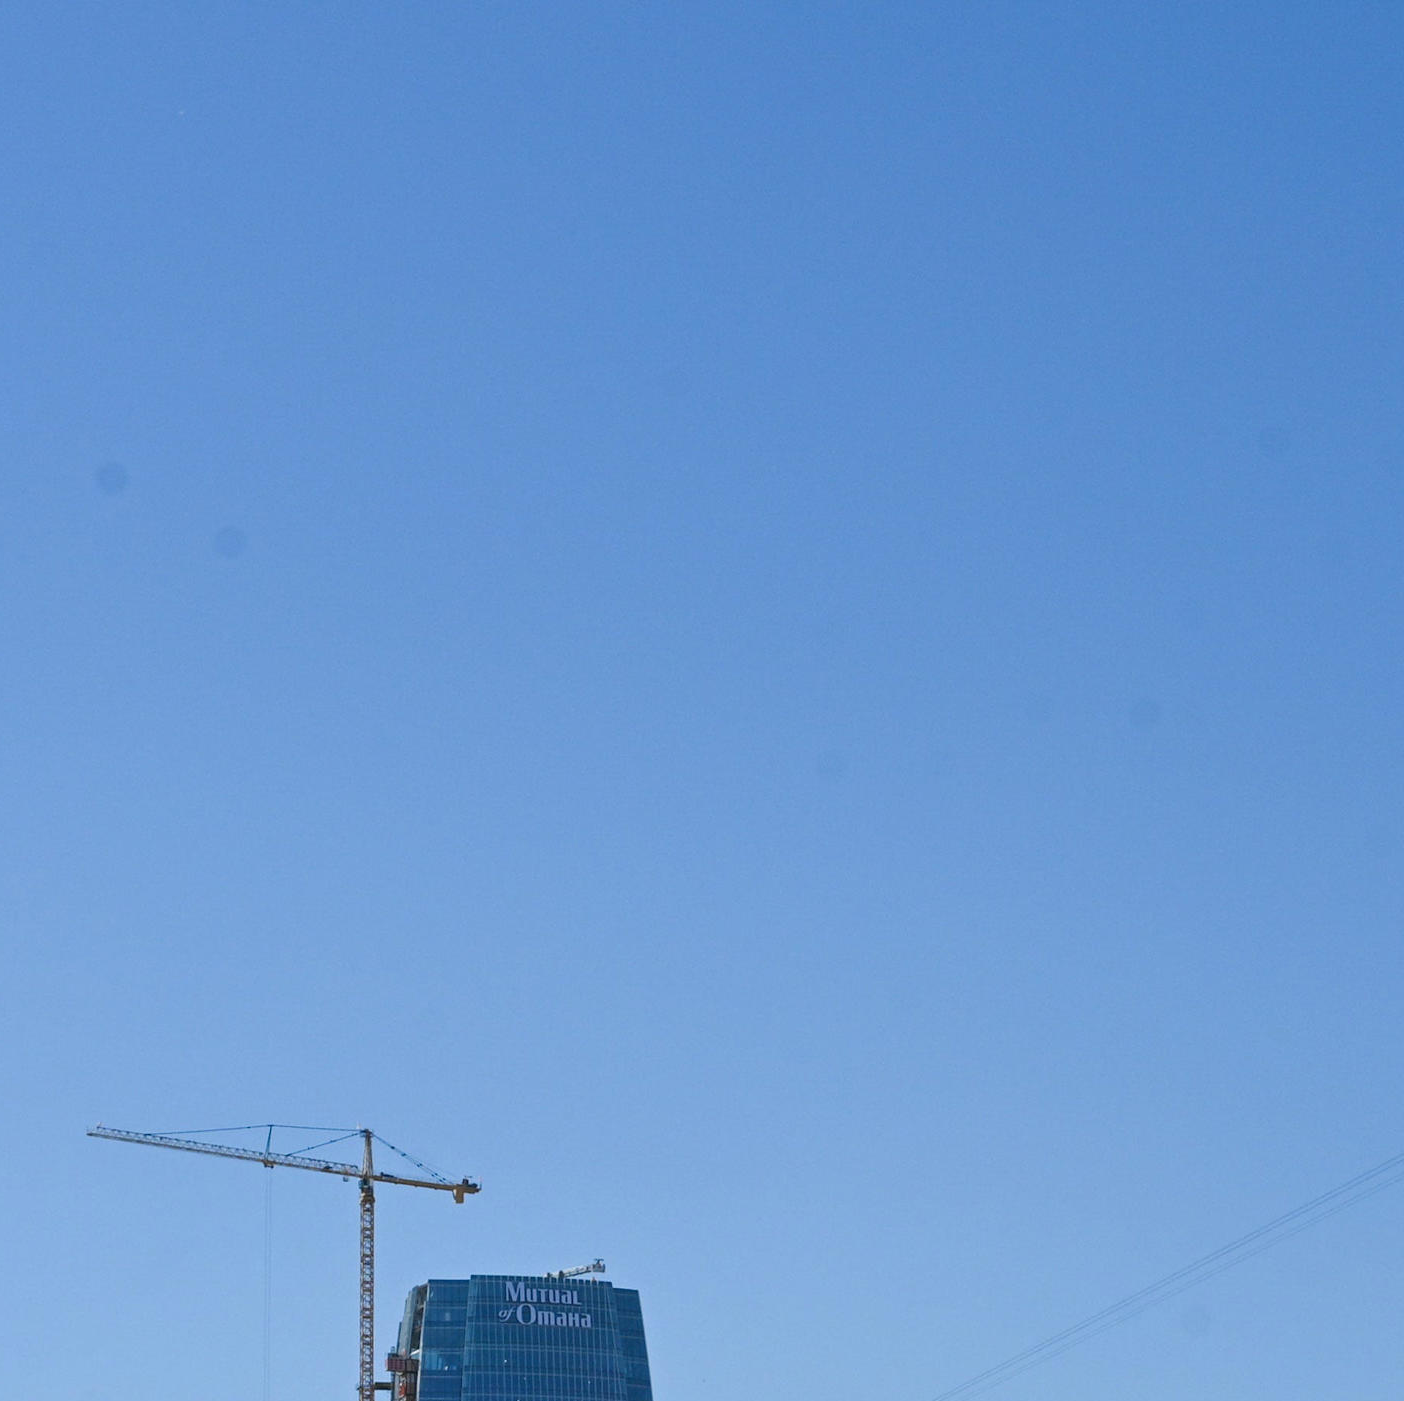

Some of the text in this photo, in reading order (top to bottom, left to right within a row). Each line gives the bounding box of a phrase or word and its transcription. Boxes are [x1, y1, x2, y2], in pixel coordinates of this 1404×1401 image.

[505, 1281, 582, 1305] Mutual
[498, 1304, 592, 1328] of Omaha
